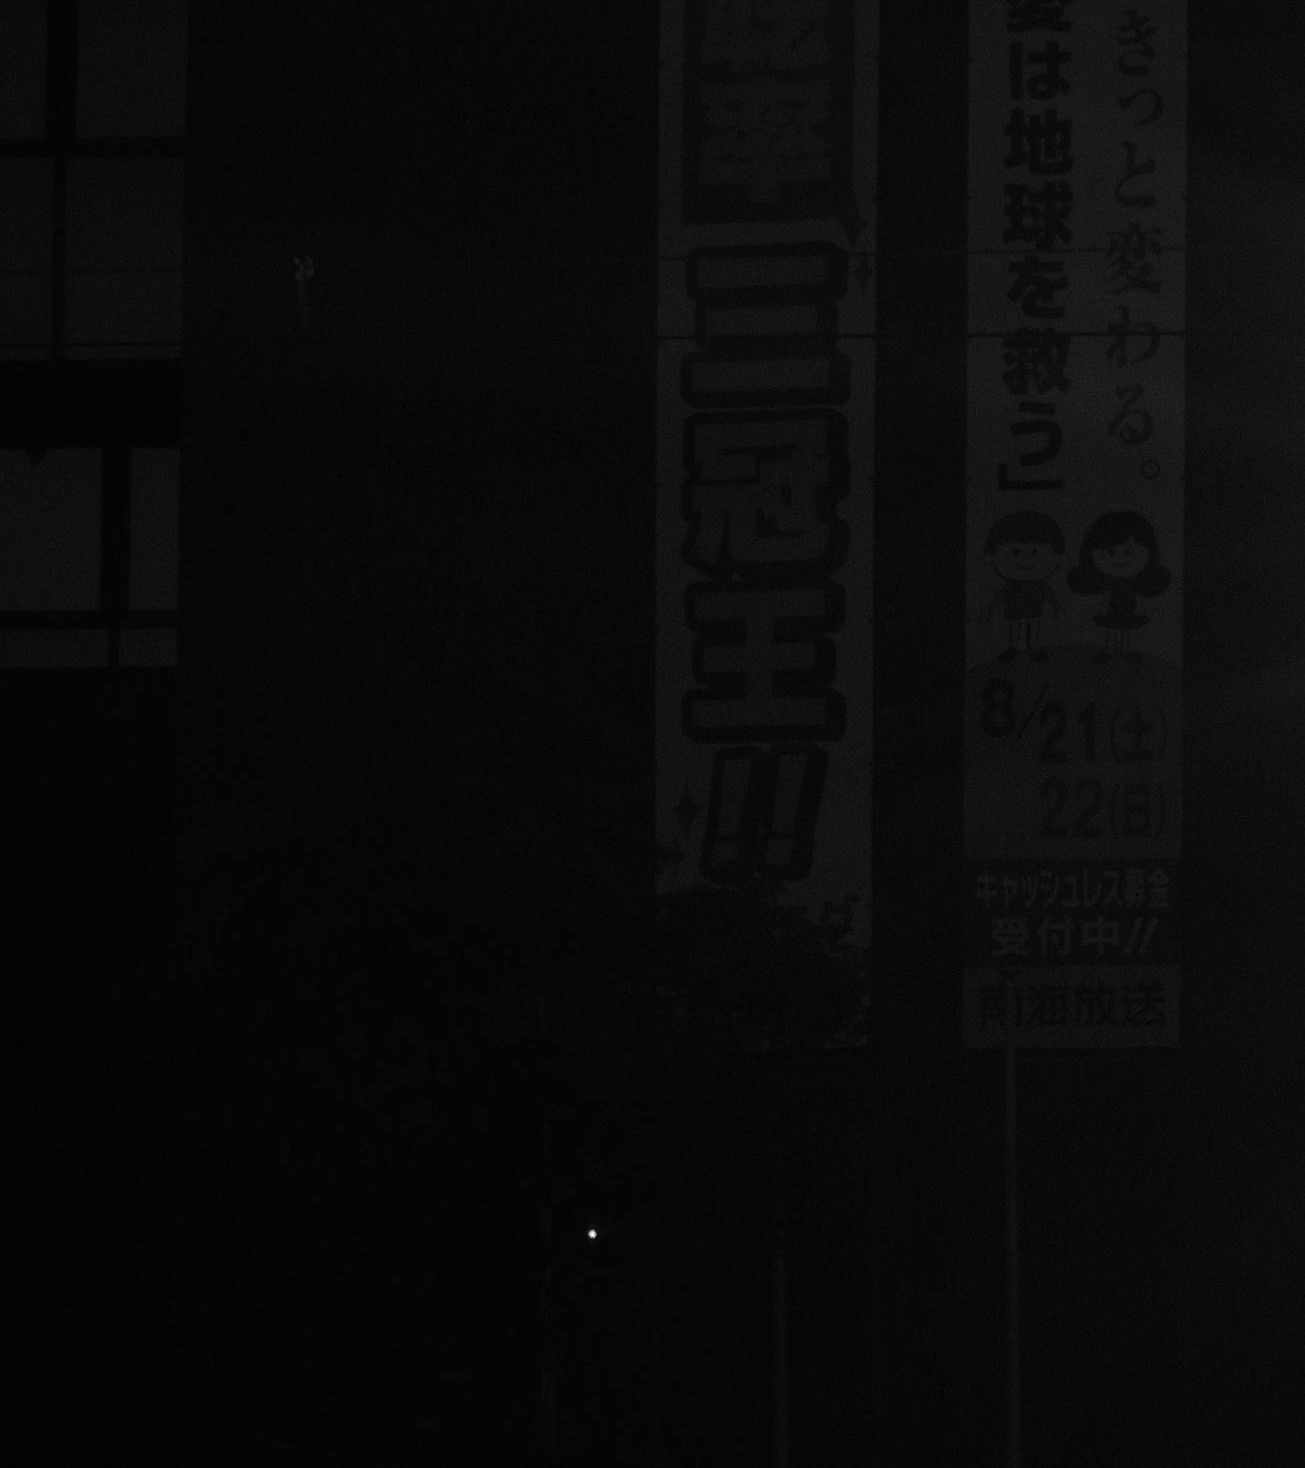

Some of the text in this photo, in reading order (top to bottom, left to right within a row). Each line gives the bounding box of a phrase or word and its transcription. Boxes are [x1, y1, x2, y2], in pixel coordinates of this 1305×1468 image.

[975, 868, 1170, 910] キャッシュレス募金
[979, 980, 1166, 1028] 南海放送
